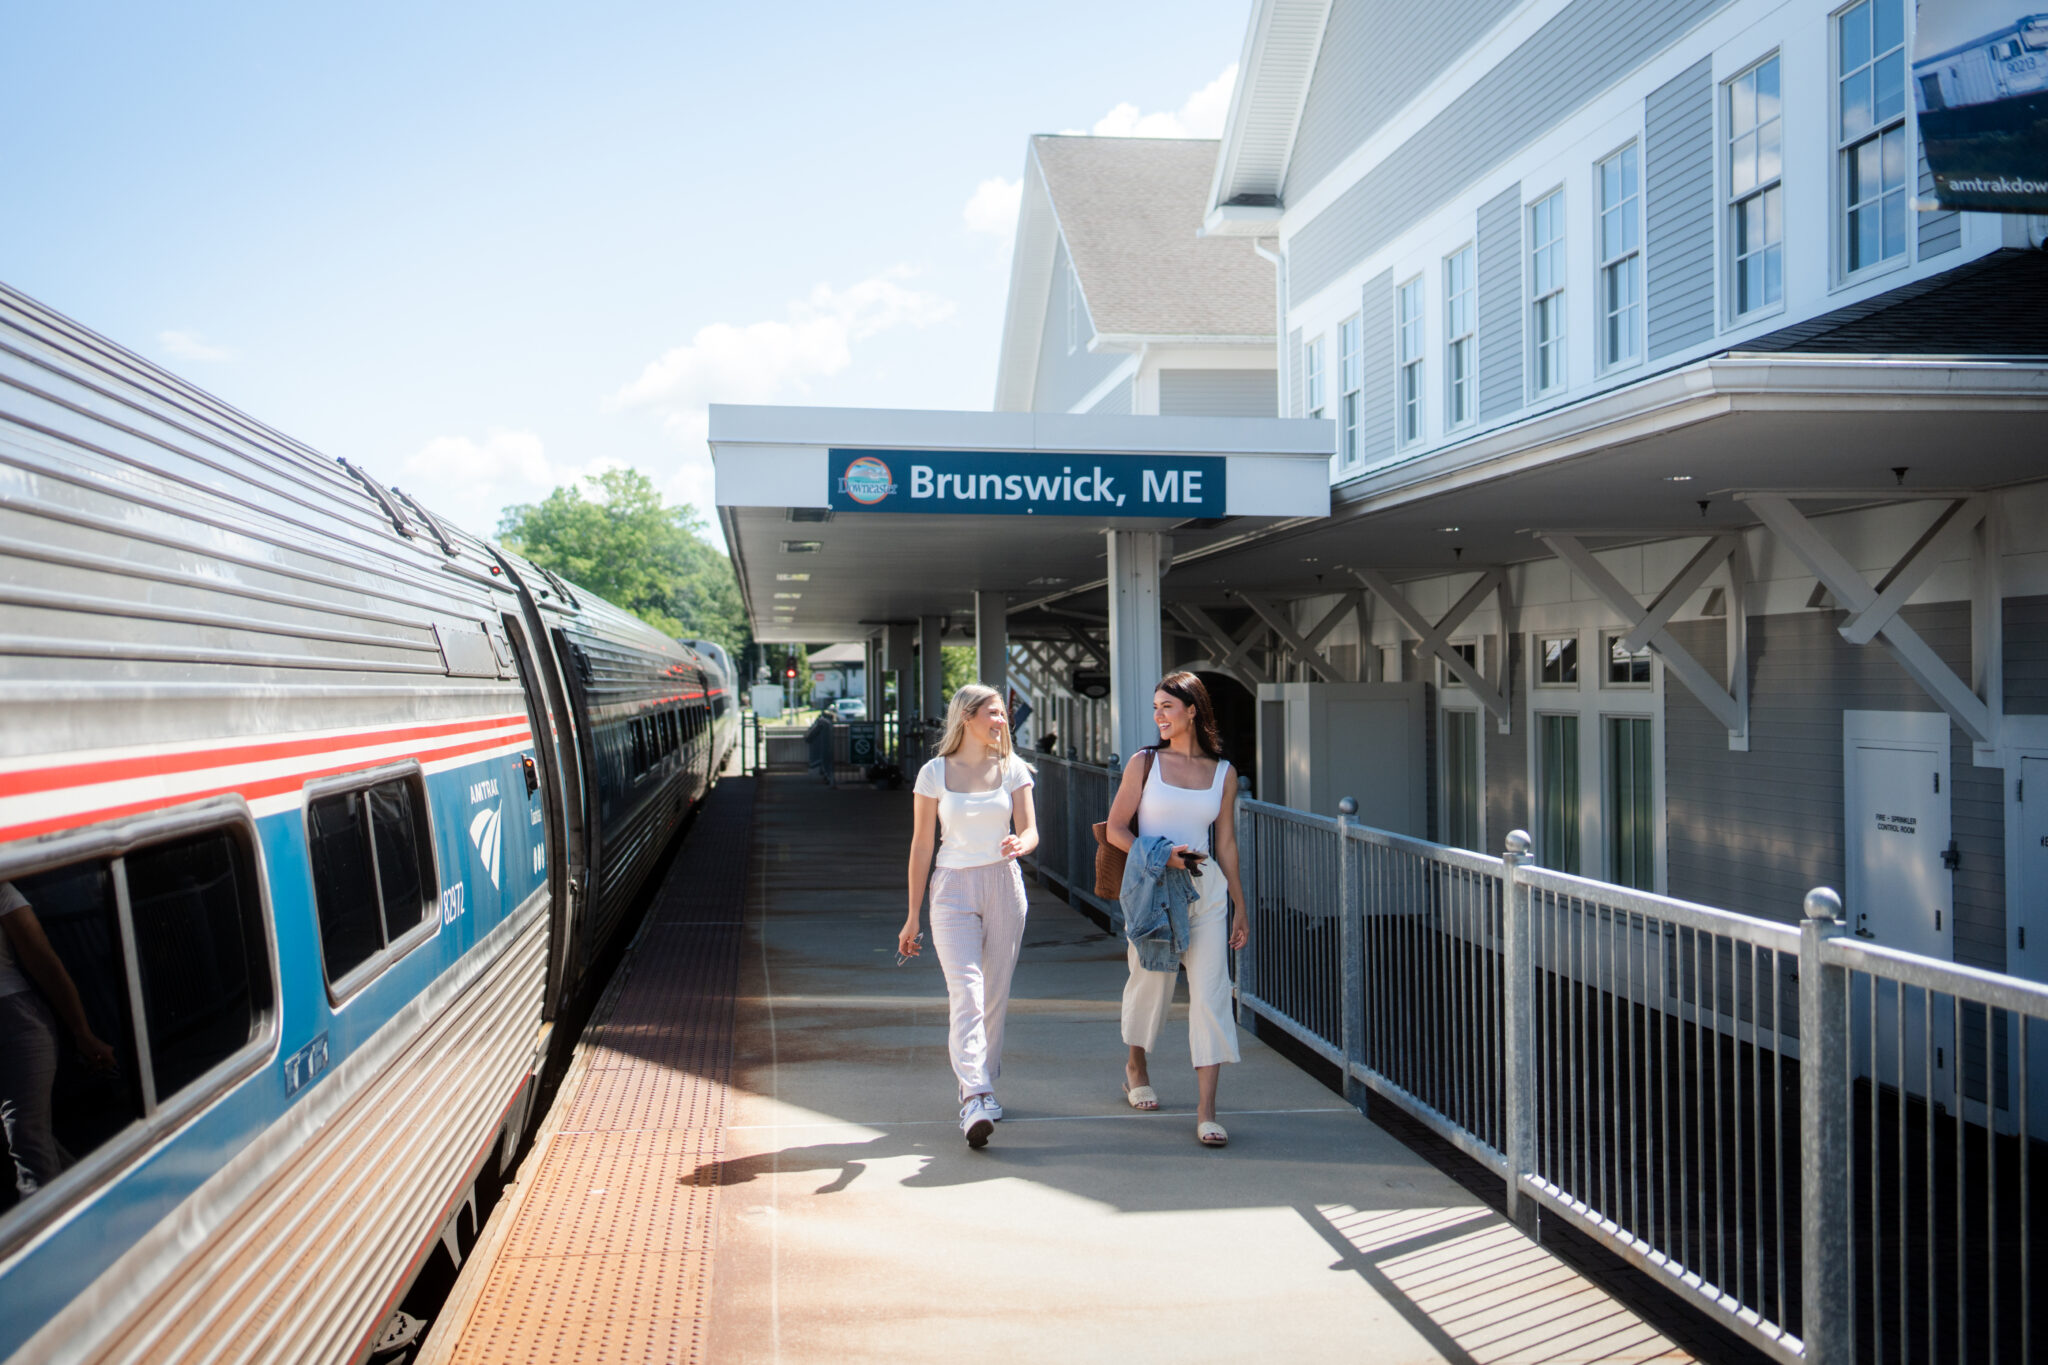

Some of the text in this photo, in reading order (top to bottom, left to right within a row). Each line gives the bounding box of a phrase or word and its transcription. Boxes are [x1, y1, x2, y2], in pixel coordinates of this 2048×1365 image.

[910, 465, 1203, 507] Brunswick, ME
[470, 778, 499, 805] AMTRAK
[1877, 822, 1915, 834] CONTROL ROOM
[443, 881, 465, 926] 82972
